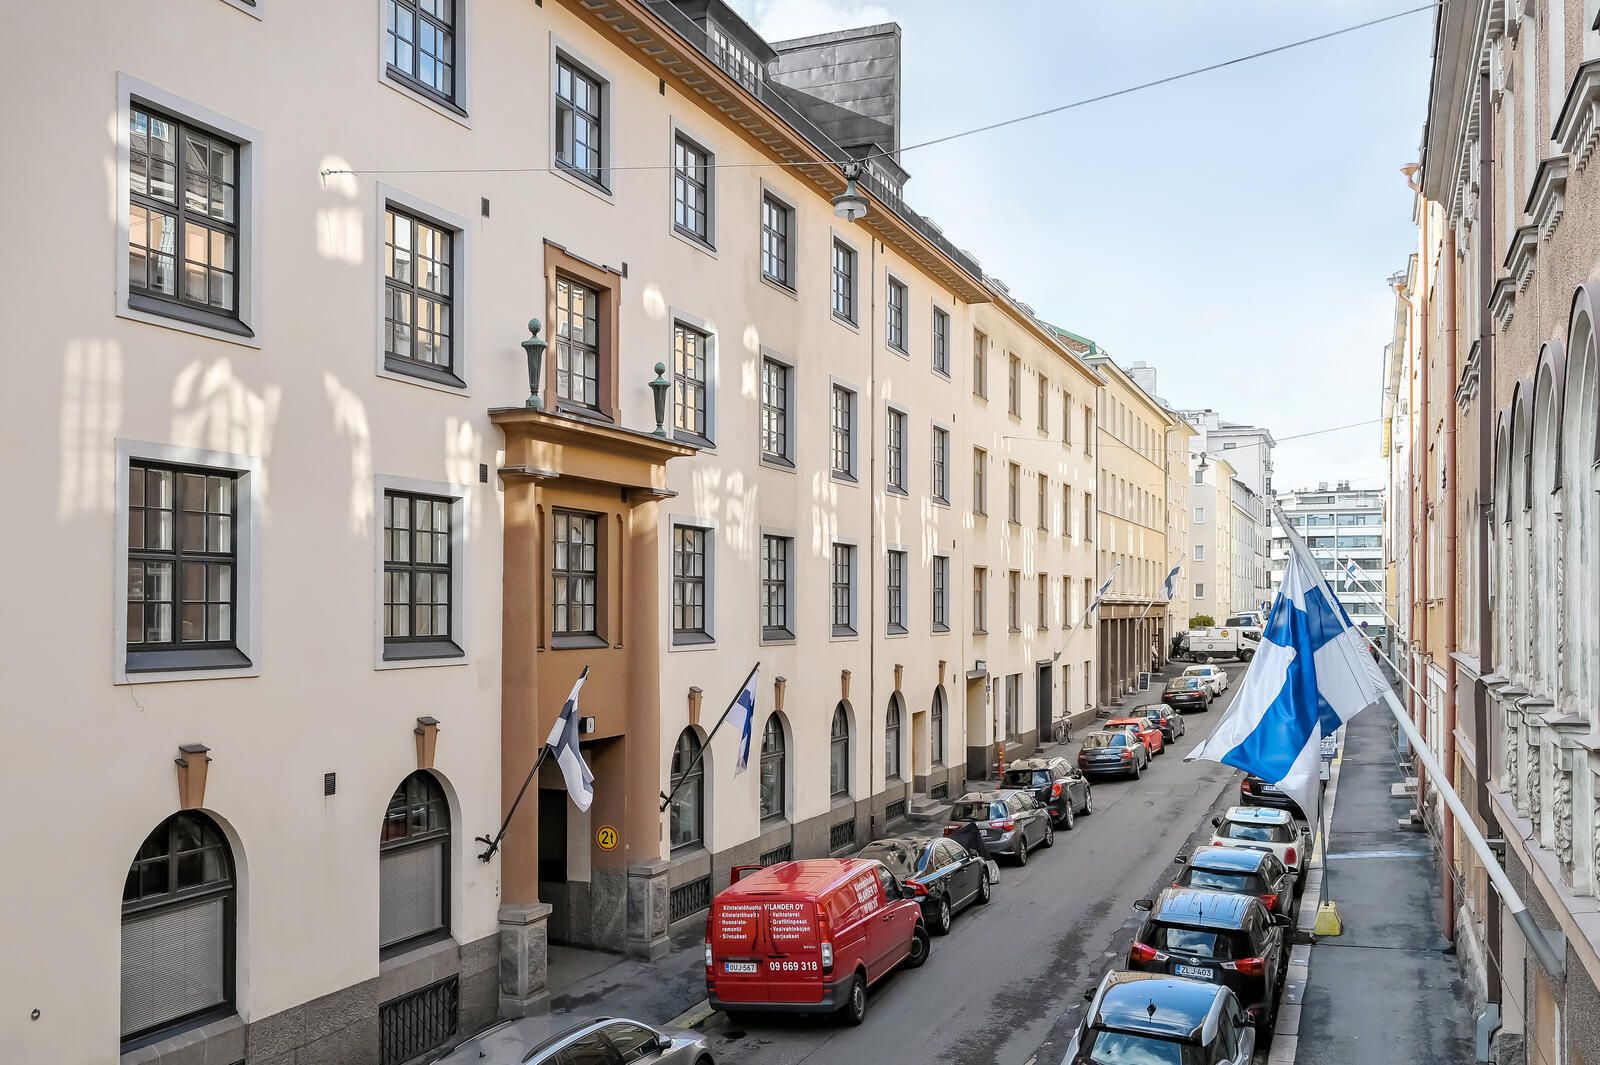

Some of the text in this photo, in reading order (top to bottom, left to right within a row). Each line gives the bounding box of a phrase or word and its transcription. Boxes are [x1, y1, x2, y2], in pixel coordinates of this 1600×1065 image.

[763, 903, 794, 911] VILANDER
[769, 961, 818, 971] 09 669 318
[1181, 966, 1212, 977] ZLJ-403
